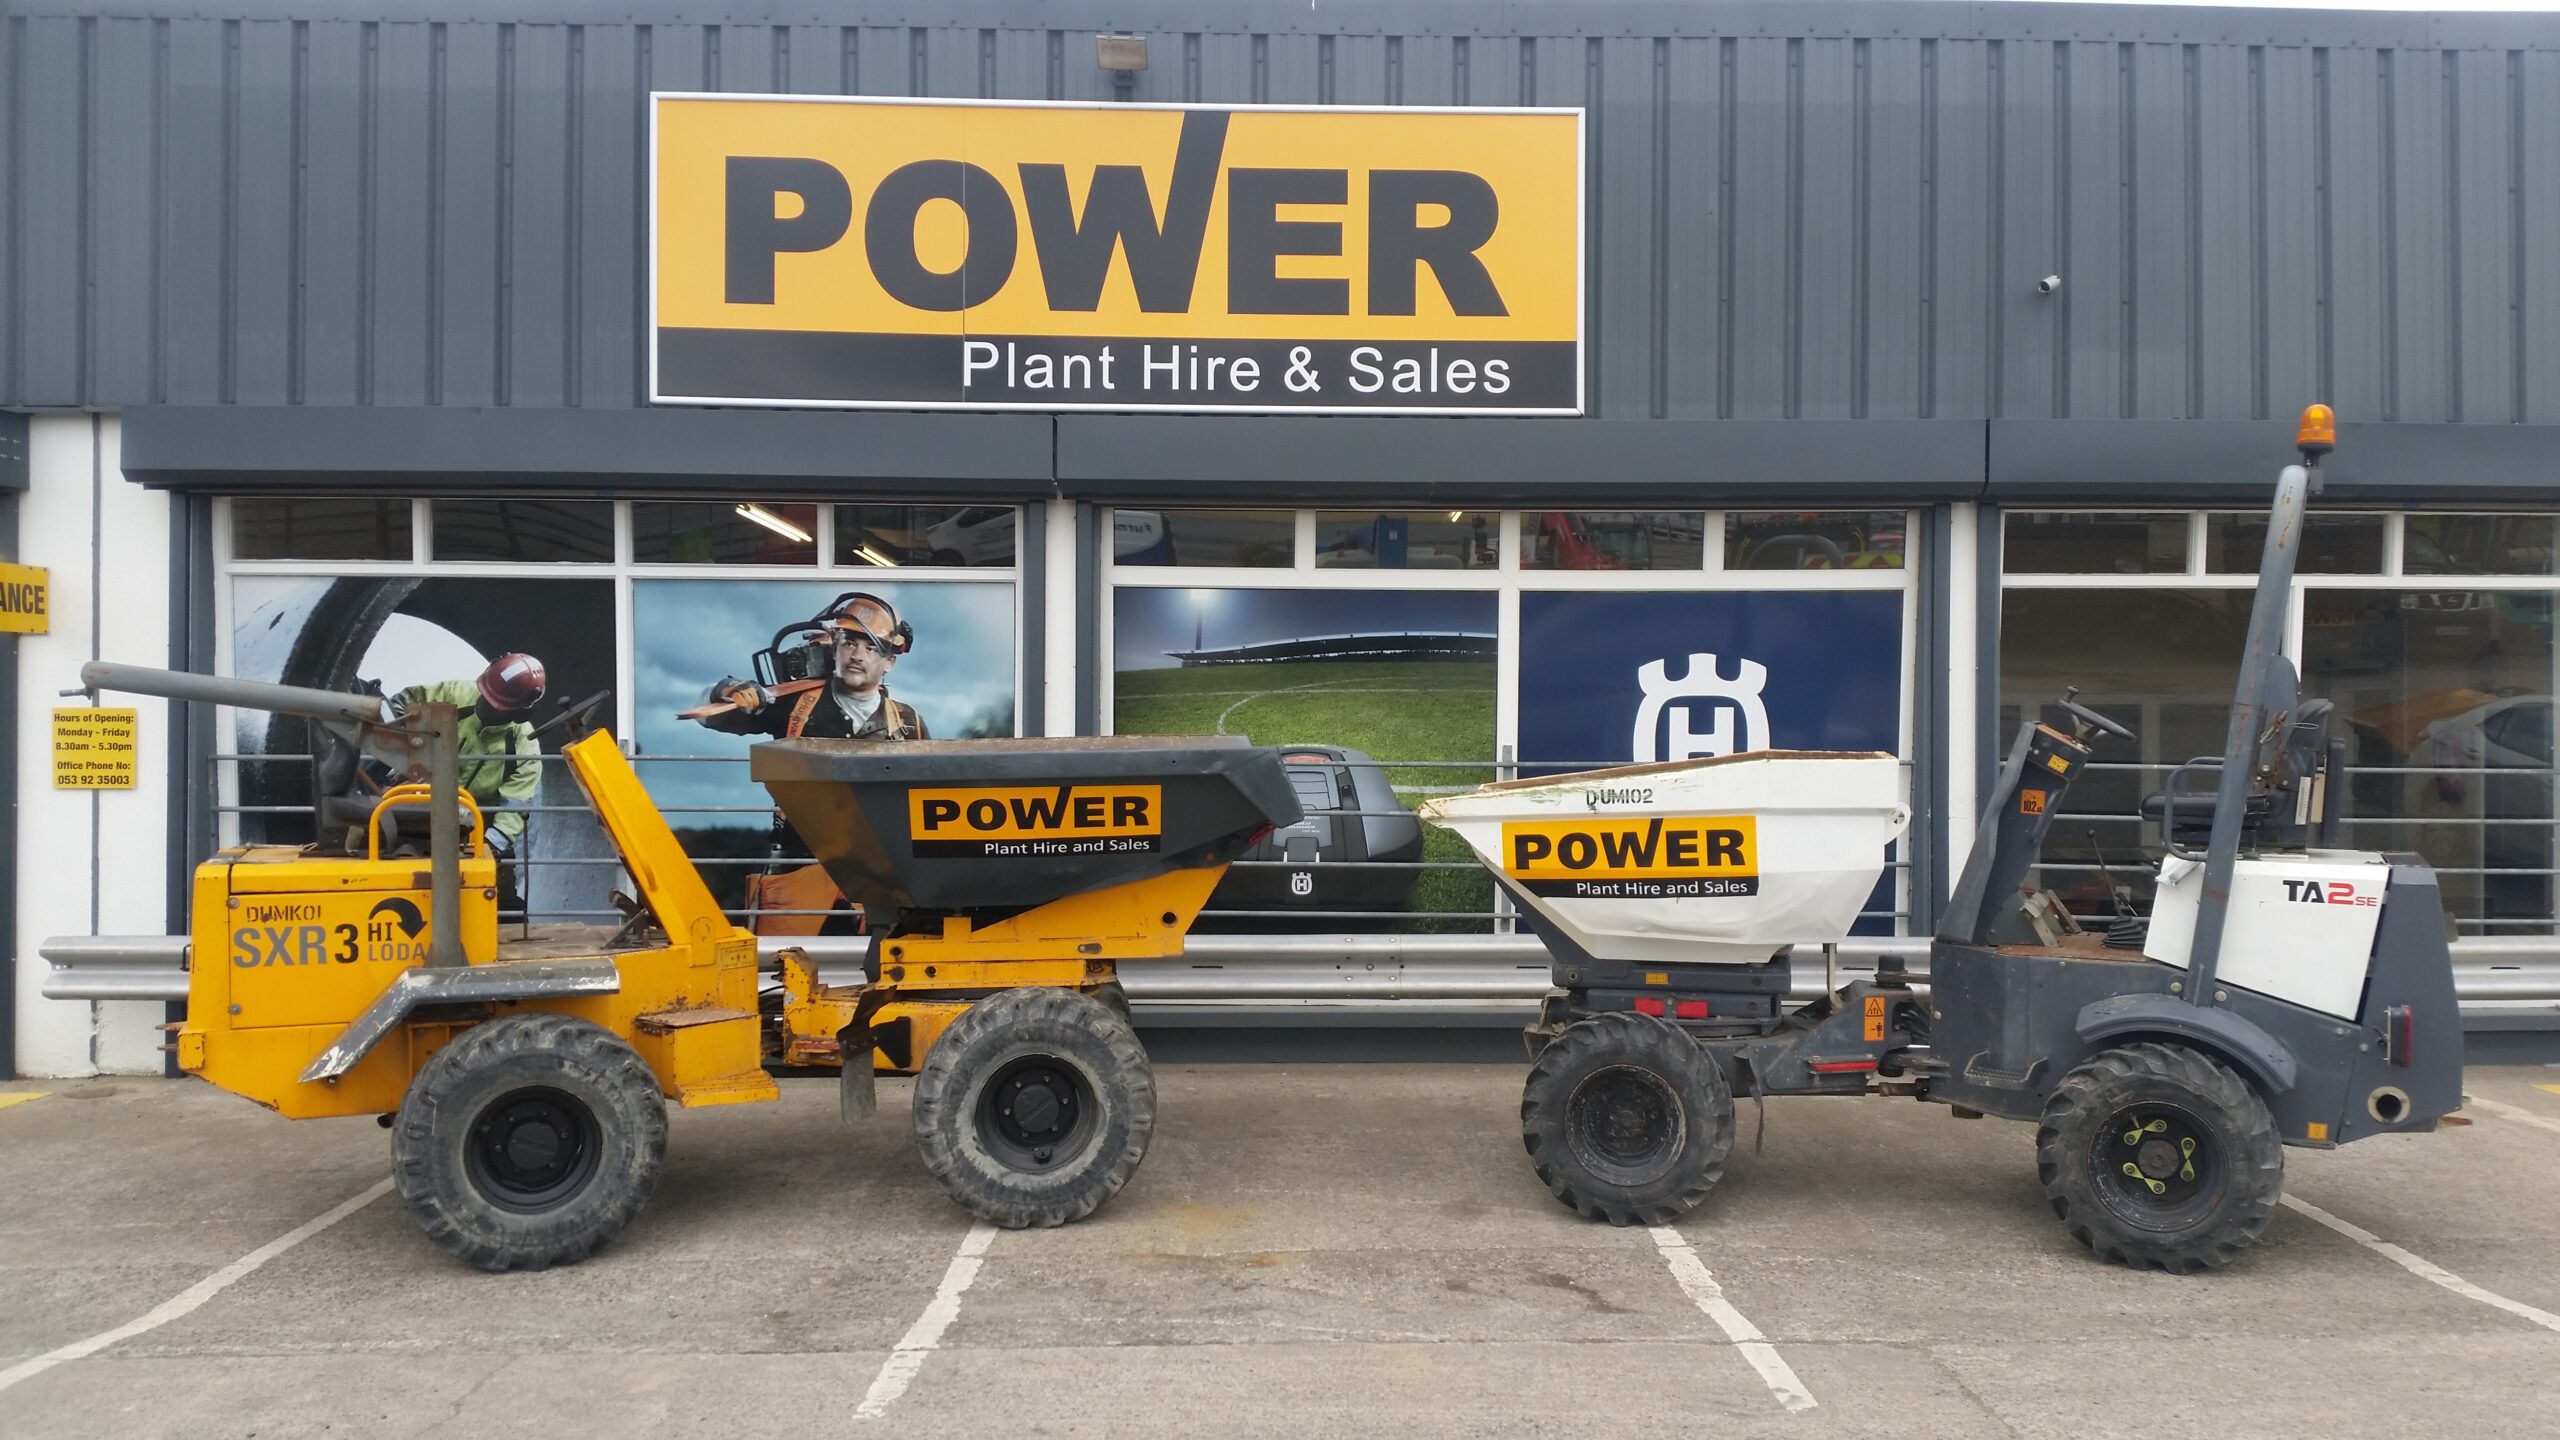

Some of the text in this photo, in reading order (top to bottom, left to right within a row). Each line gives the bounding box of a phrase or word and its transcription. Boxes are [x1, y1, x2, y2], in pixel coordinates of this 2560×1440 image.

[725, 111, 1511, 318] POWER
[964, 341, 1511, 394] Plant Hire & Sales
[54, 714, 134, 724] Hours of Opening:
[57, 728, 93, 738] Monday
[102, 728, 130, 738] Friday
[56, 742, 89, 750] 8.30am
[98, 743, 132, 752] 5.30pm
[57, 761, 130, 770] Office Phone No:
[57, 775, 130, 785] 053 92 35003
[923, 786, 1150, 831] POWER
[2023, 800, 2036, 812] 102
[984, 838, 1150, 855] Plant Hire and Sales
[1514, 817, 1746, 870] POWER
[1576, 880, 1748, 895] Plant Hire and Sales
[233, 922, 392, 968] SXR 3 HI
